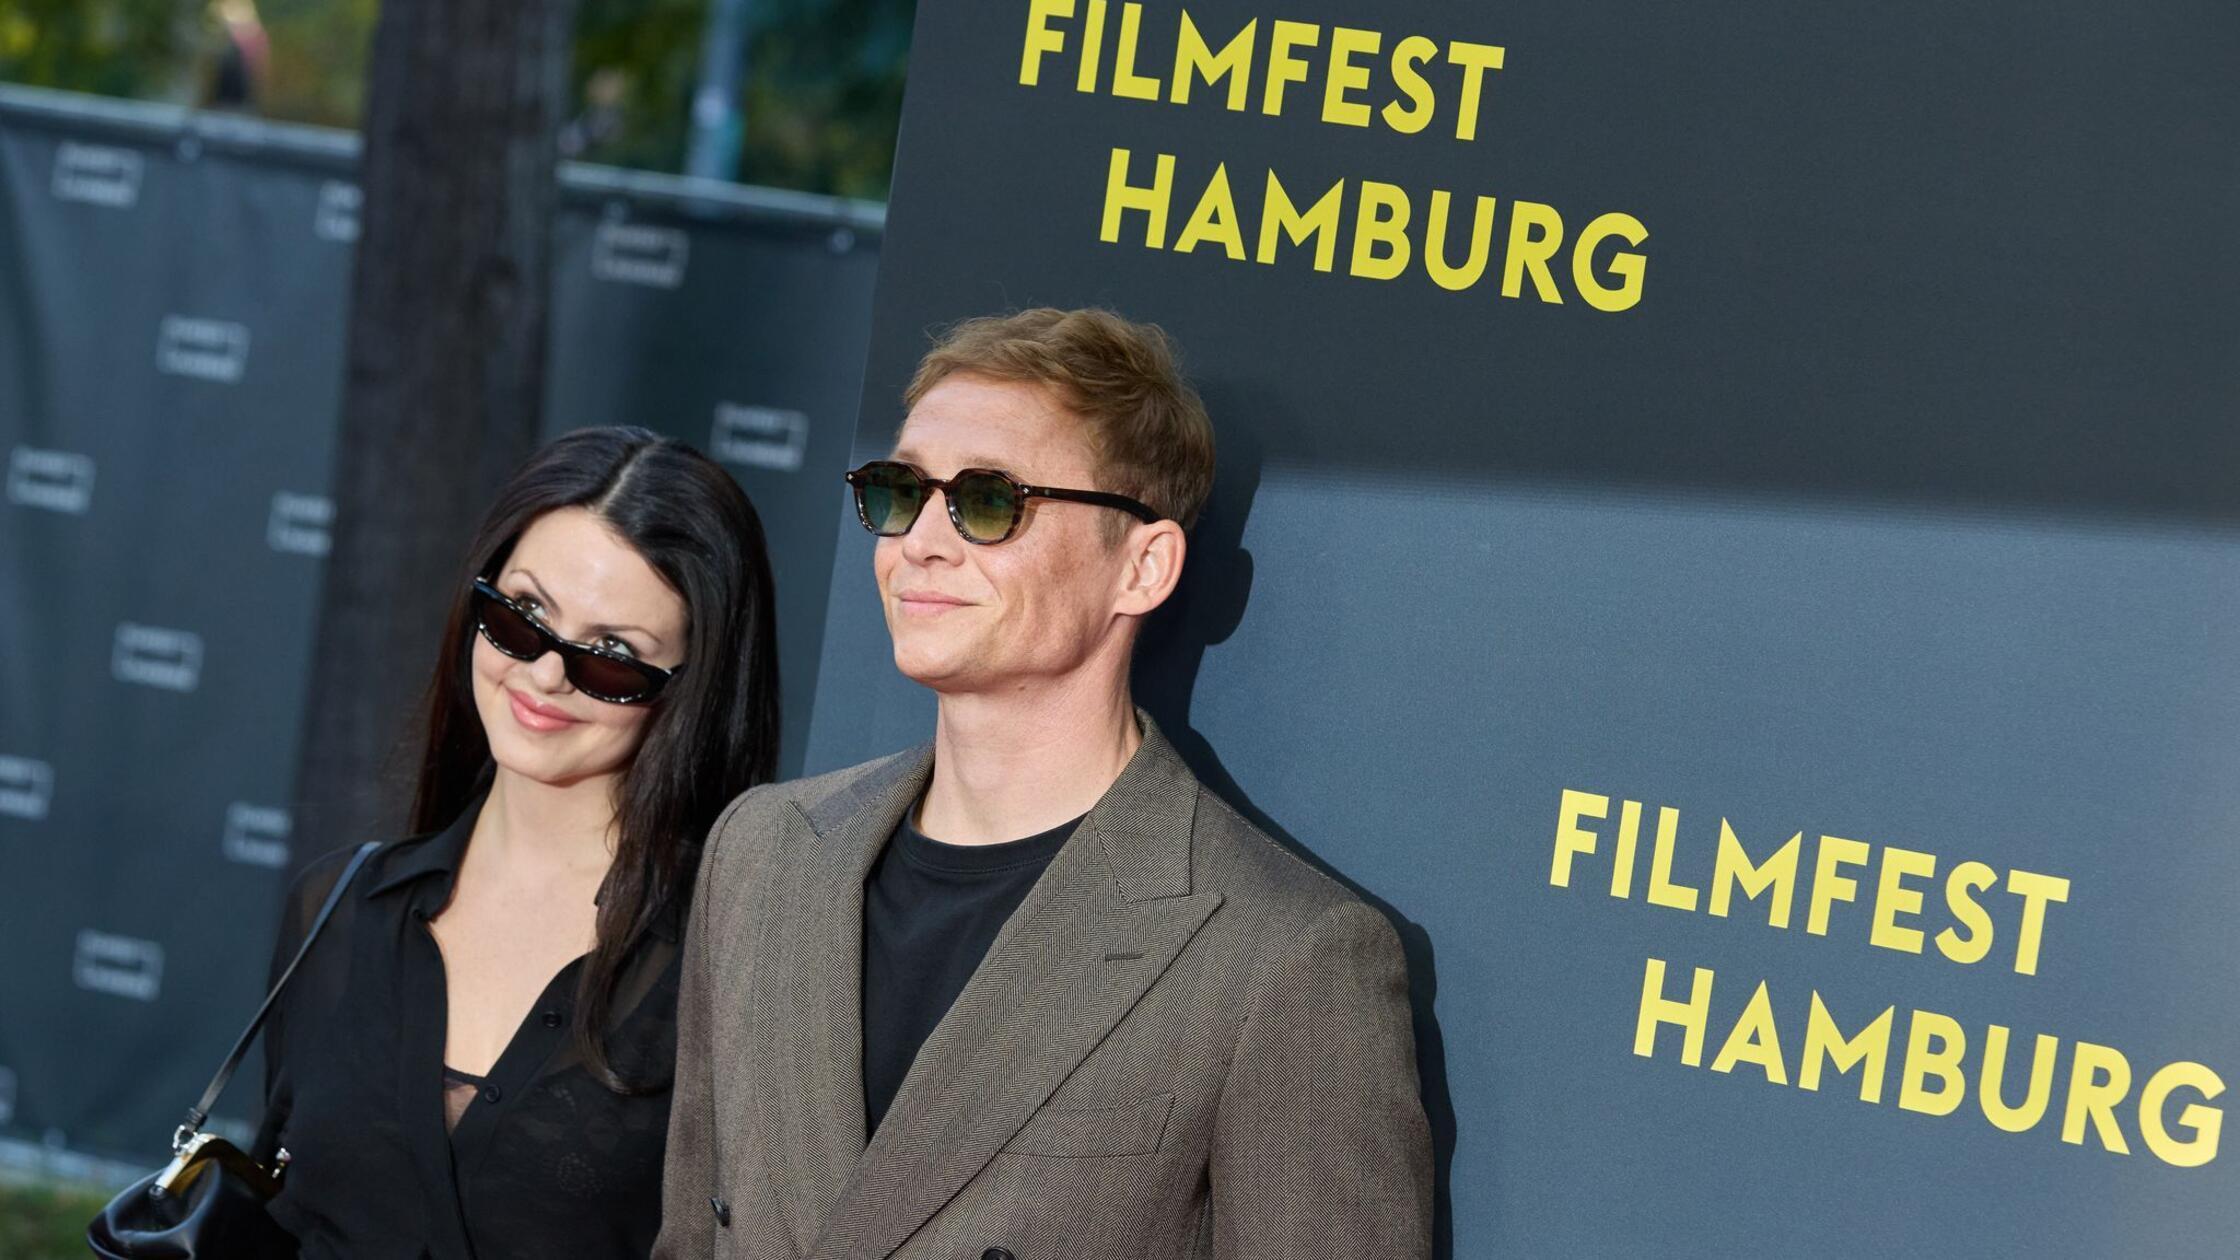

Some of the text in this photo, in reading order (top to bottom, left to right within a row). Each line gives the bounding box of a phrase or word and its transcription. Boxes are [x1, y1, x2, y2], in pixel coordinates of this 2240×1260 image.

[1019, 0, 1505, 140] FILMFEST
[1100, 148, 1649, 313] HAMBURG
[1550, 789, 2070, 976] FILMFEST
[1633, 958, 2225, 1167] HAMBURG
